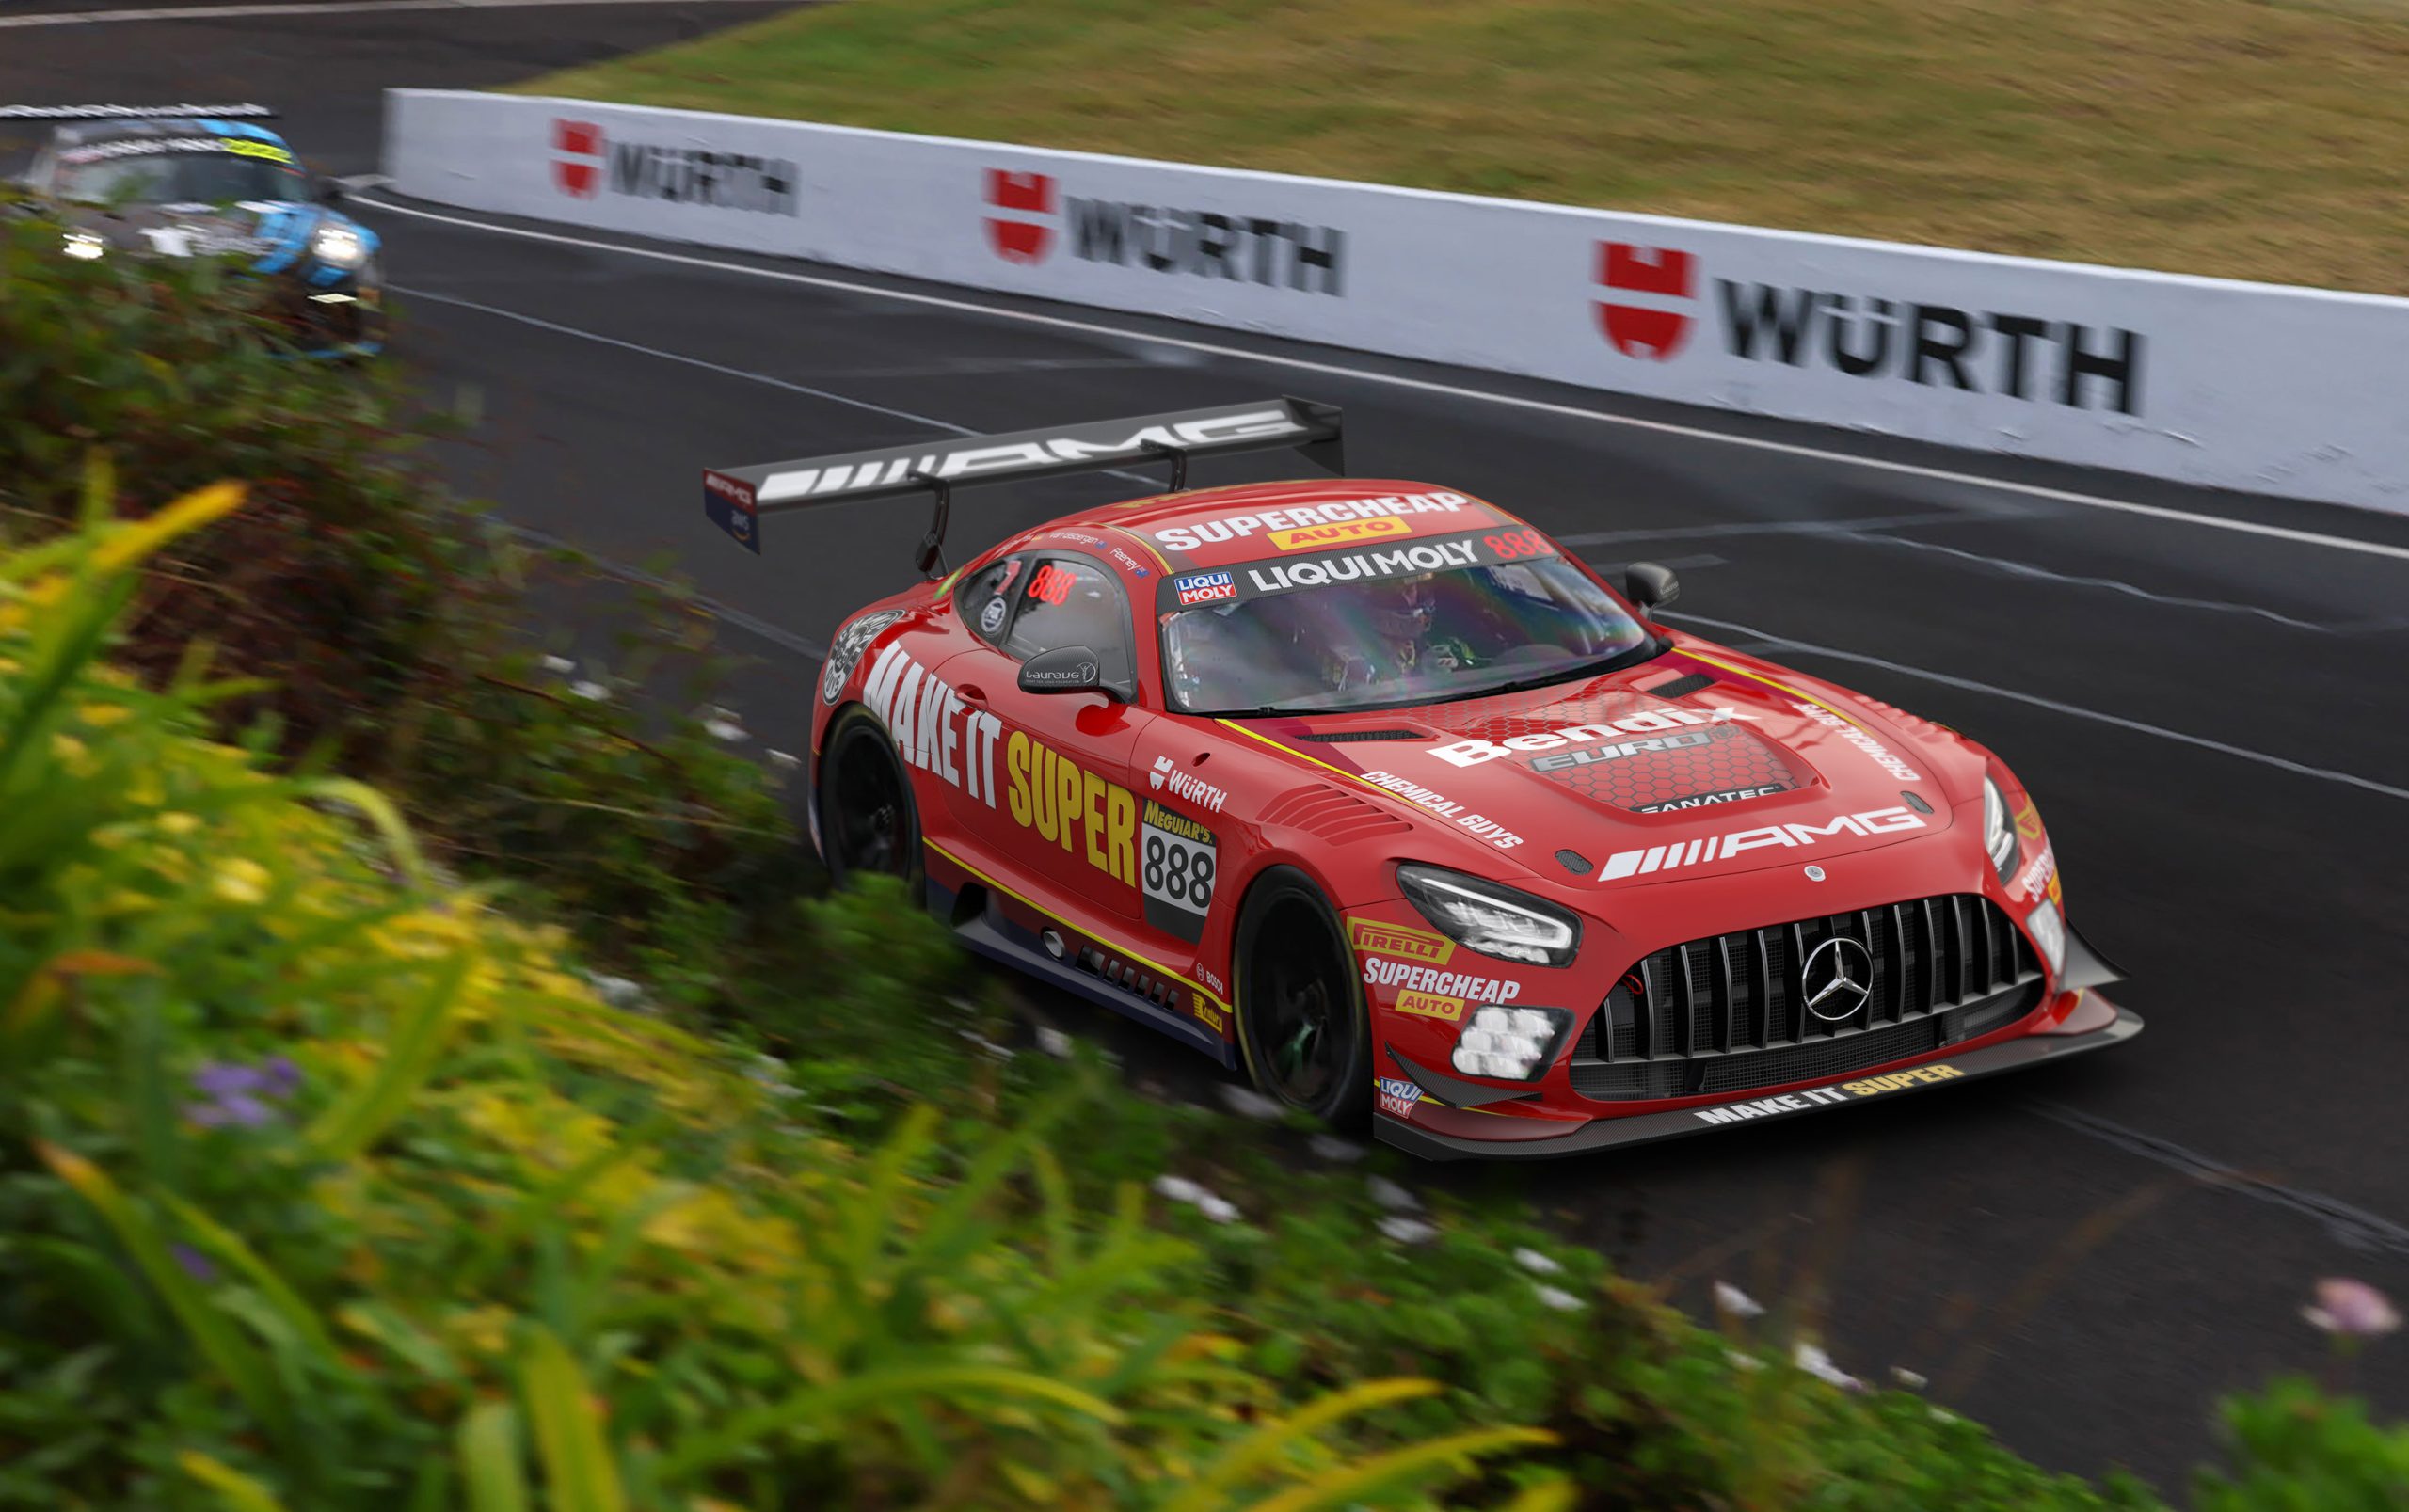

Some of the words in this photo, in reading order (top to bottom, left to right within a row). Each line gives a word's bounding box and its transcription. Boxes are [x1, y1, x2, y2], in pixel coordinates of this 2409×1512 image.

[1713, 277, 2149, 418] WÜRTH
[1154, 491, 1472, 552] SUPERCHEAP
[1281, 520, 1395, 545] AUTO
[1178, 573, 1229, 591] LIQUI
[1248, 551, 1376, 592] LIQUI
[1369, 540, 1479, 576] MOLY
[1483, 530, 1555, 560] 888
[1028, 565, 1077, 607] 888
[1182, 584, 1233, 603] MOLY
[1026, 671, 1080, 679] Laureus
[1425, 706, 1763, 769] Bendix
[863, 639, 966, 788] MAKE
[966, 708, 1002, 810] IT
[1007, 729, 1137, 889] SUPER
[1168, 769, 1228, 814] WÜRTH
[1359, 771, 1466, 819] CHEMICAL
[1456, 814, 1524, 849] GUYS
[1719, 806, 1927, 859] AMG
[1144, 835, 1215, 909] 888
[1353, 923, 1445, 959] PIRELLI
[1364, 957, 1521, 1004] SUPERCHEAP
[1401, 995, 1456, 1015] AUTO
[1380, 1078, 1423, 1101] LIQUI
[1381, 1093, 1412, 1116] MOLY
[1694, 1094, 1809, 1127] MAKE
[1800, 1087, 1848, 1107] IT
[1841, 1063, 1966, 1098] SUPER
